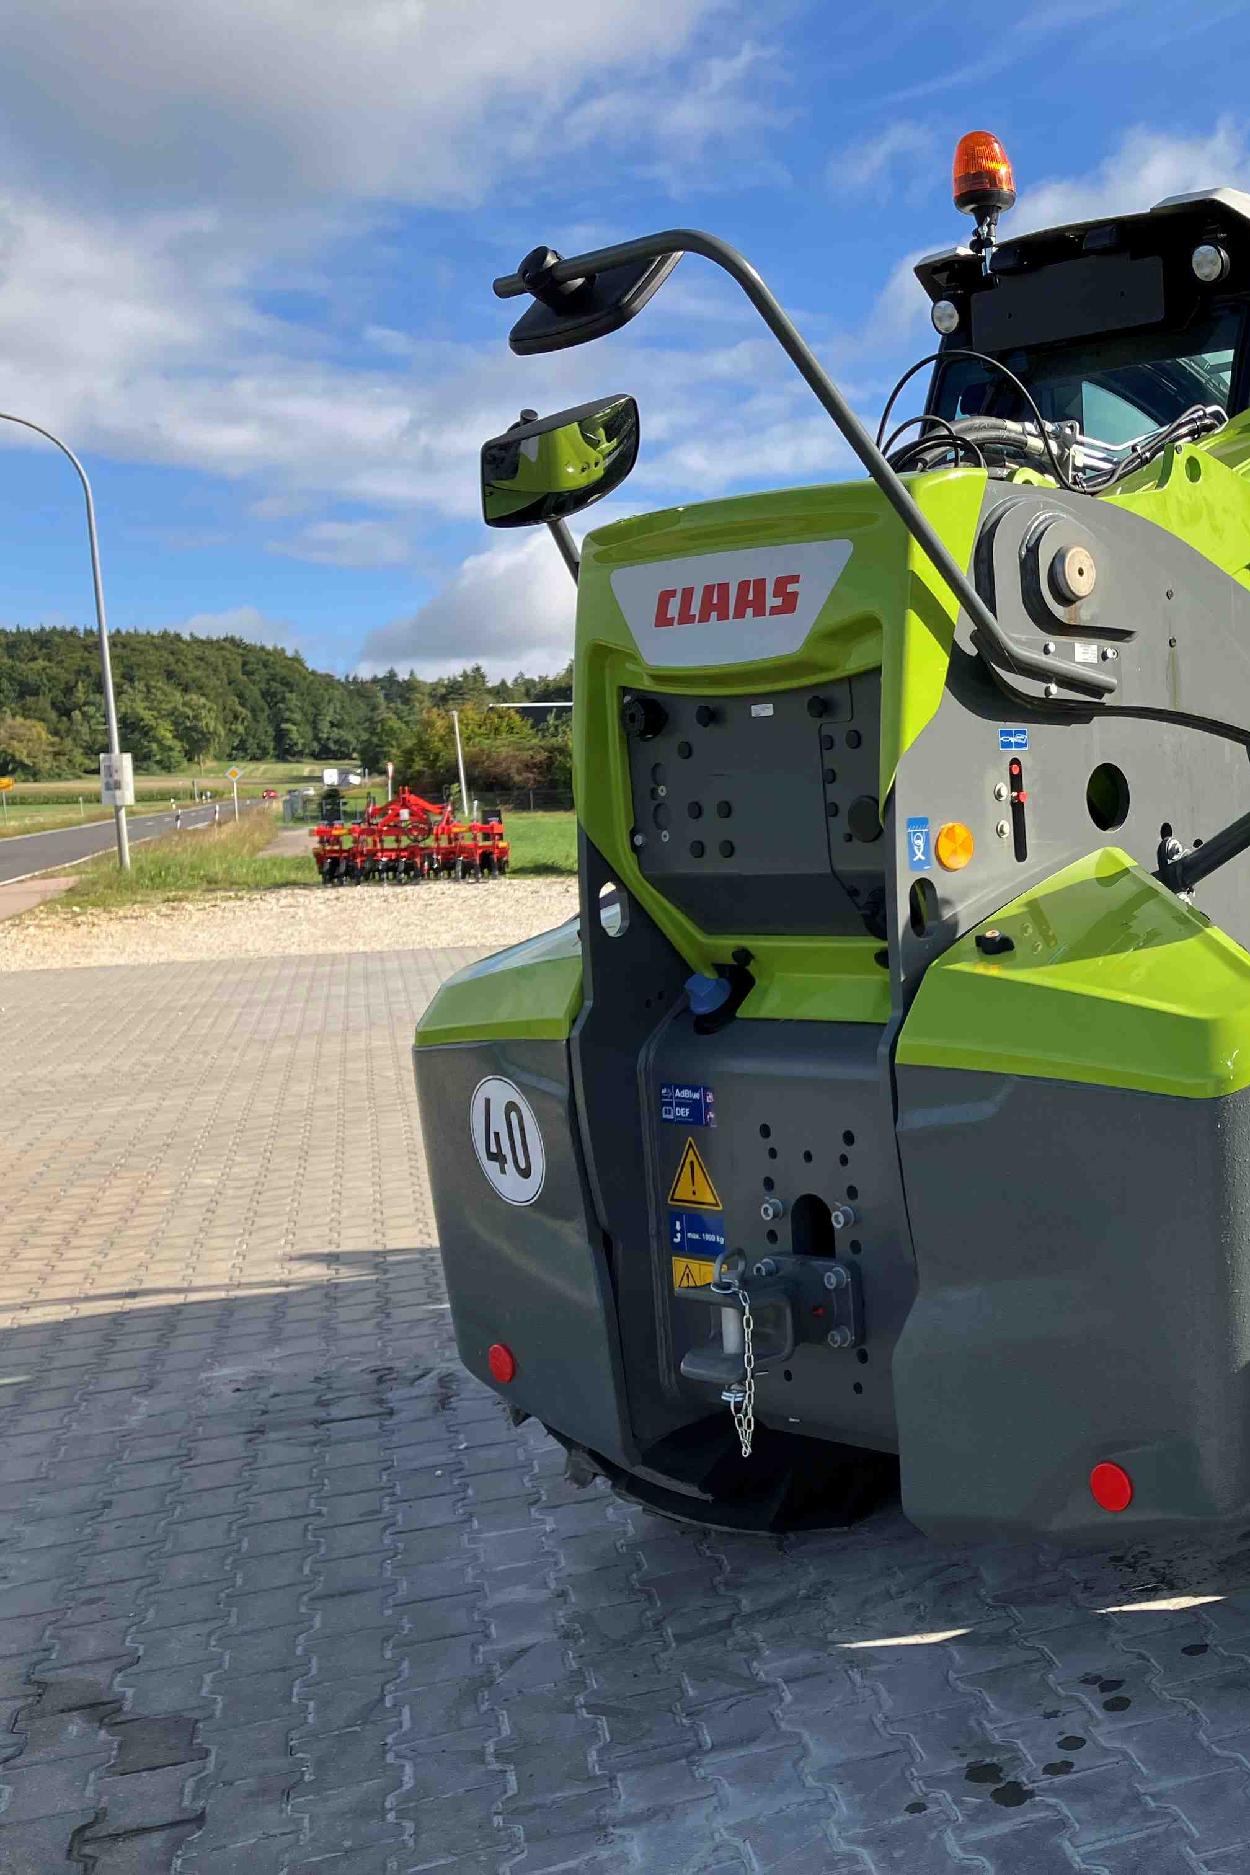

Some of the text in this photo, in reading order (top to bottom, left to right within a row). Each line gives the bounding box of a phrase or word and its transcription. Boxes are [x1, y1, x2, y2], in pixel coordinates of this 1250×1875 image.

[654, 574, 801, 628] CLAAS
[484, 1097, 532, 1180] 40
[675, 1107, 690, 1117] DEF
